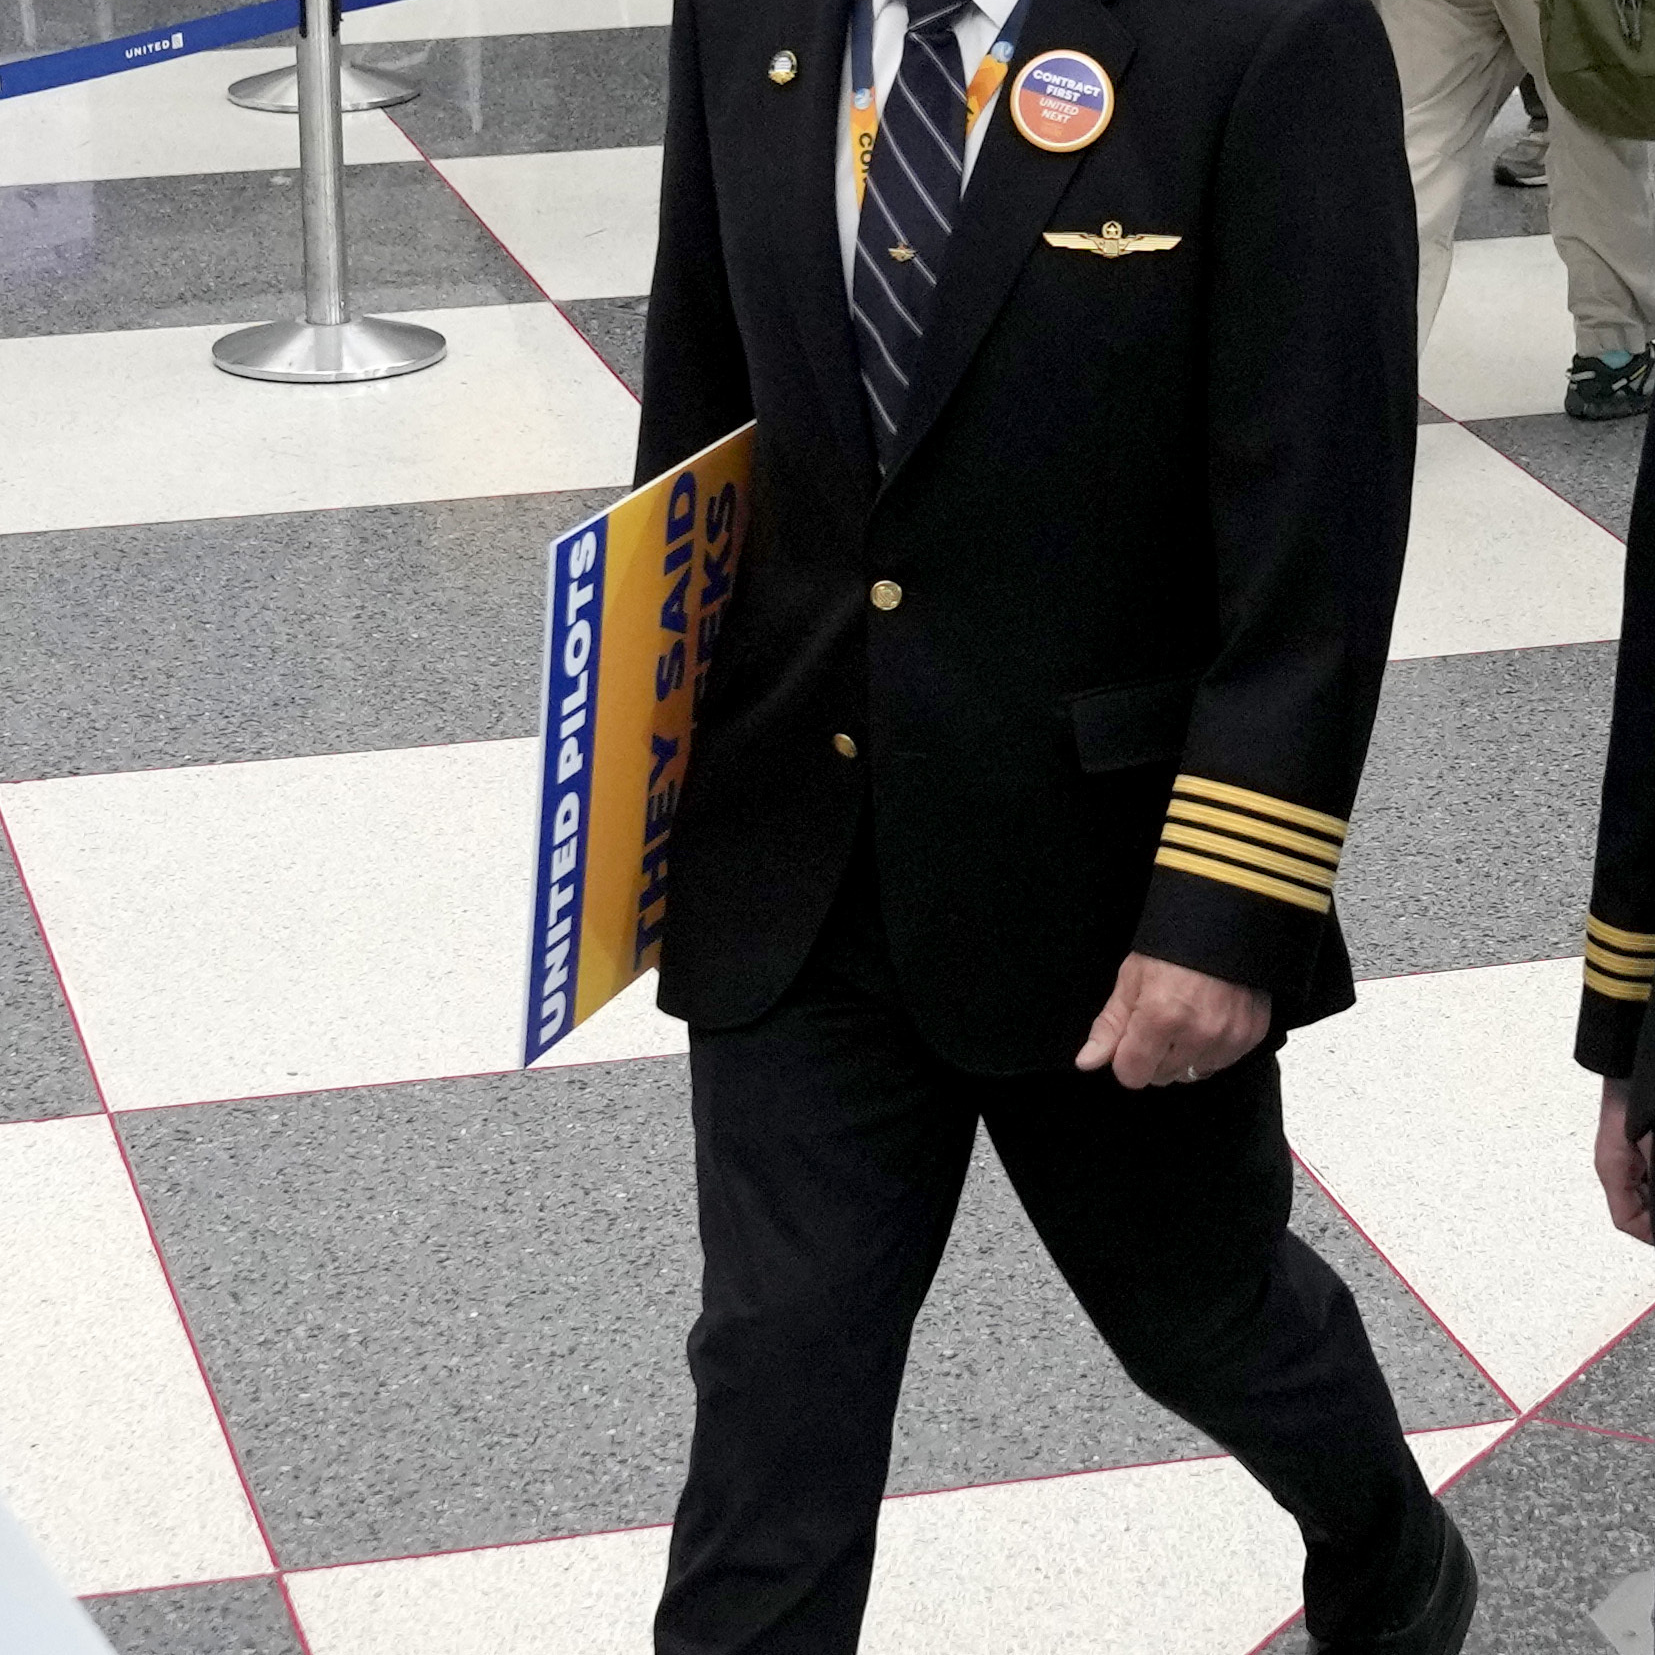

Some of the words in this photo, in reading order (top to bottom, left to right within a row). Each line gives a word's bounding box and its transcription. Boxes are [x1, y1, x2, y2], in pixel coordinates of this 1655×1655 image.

[125, 39, 170, 59] UNITED
[1032, 69, 1102, 97] CONTRACT
[1046, 85, 1081, 102] FIRST
[1039, 97, 1079, 116] UNITED
[1041, 109, 1071, 124] NEXT
[656, 470, 698, 707] SAID
[557, 530, 599, 787] PILOTS
[633, 732, 681, 975] THEY
[538, 789, 583, 1046] UNITED
